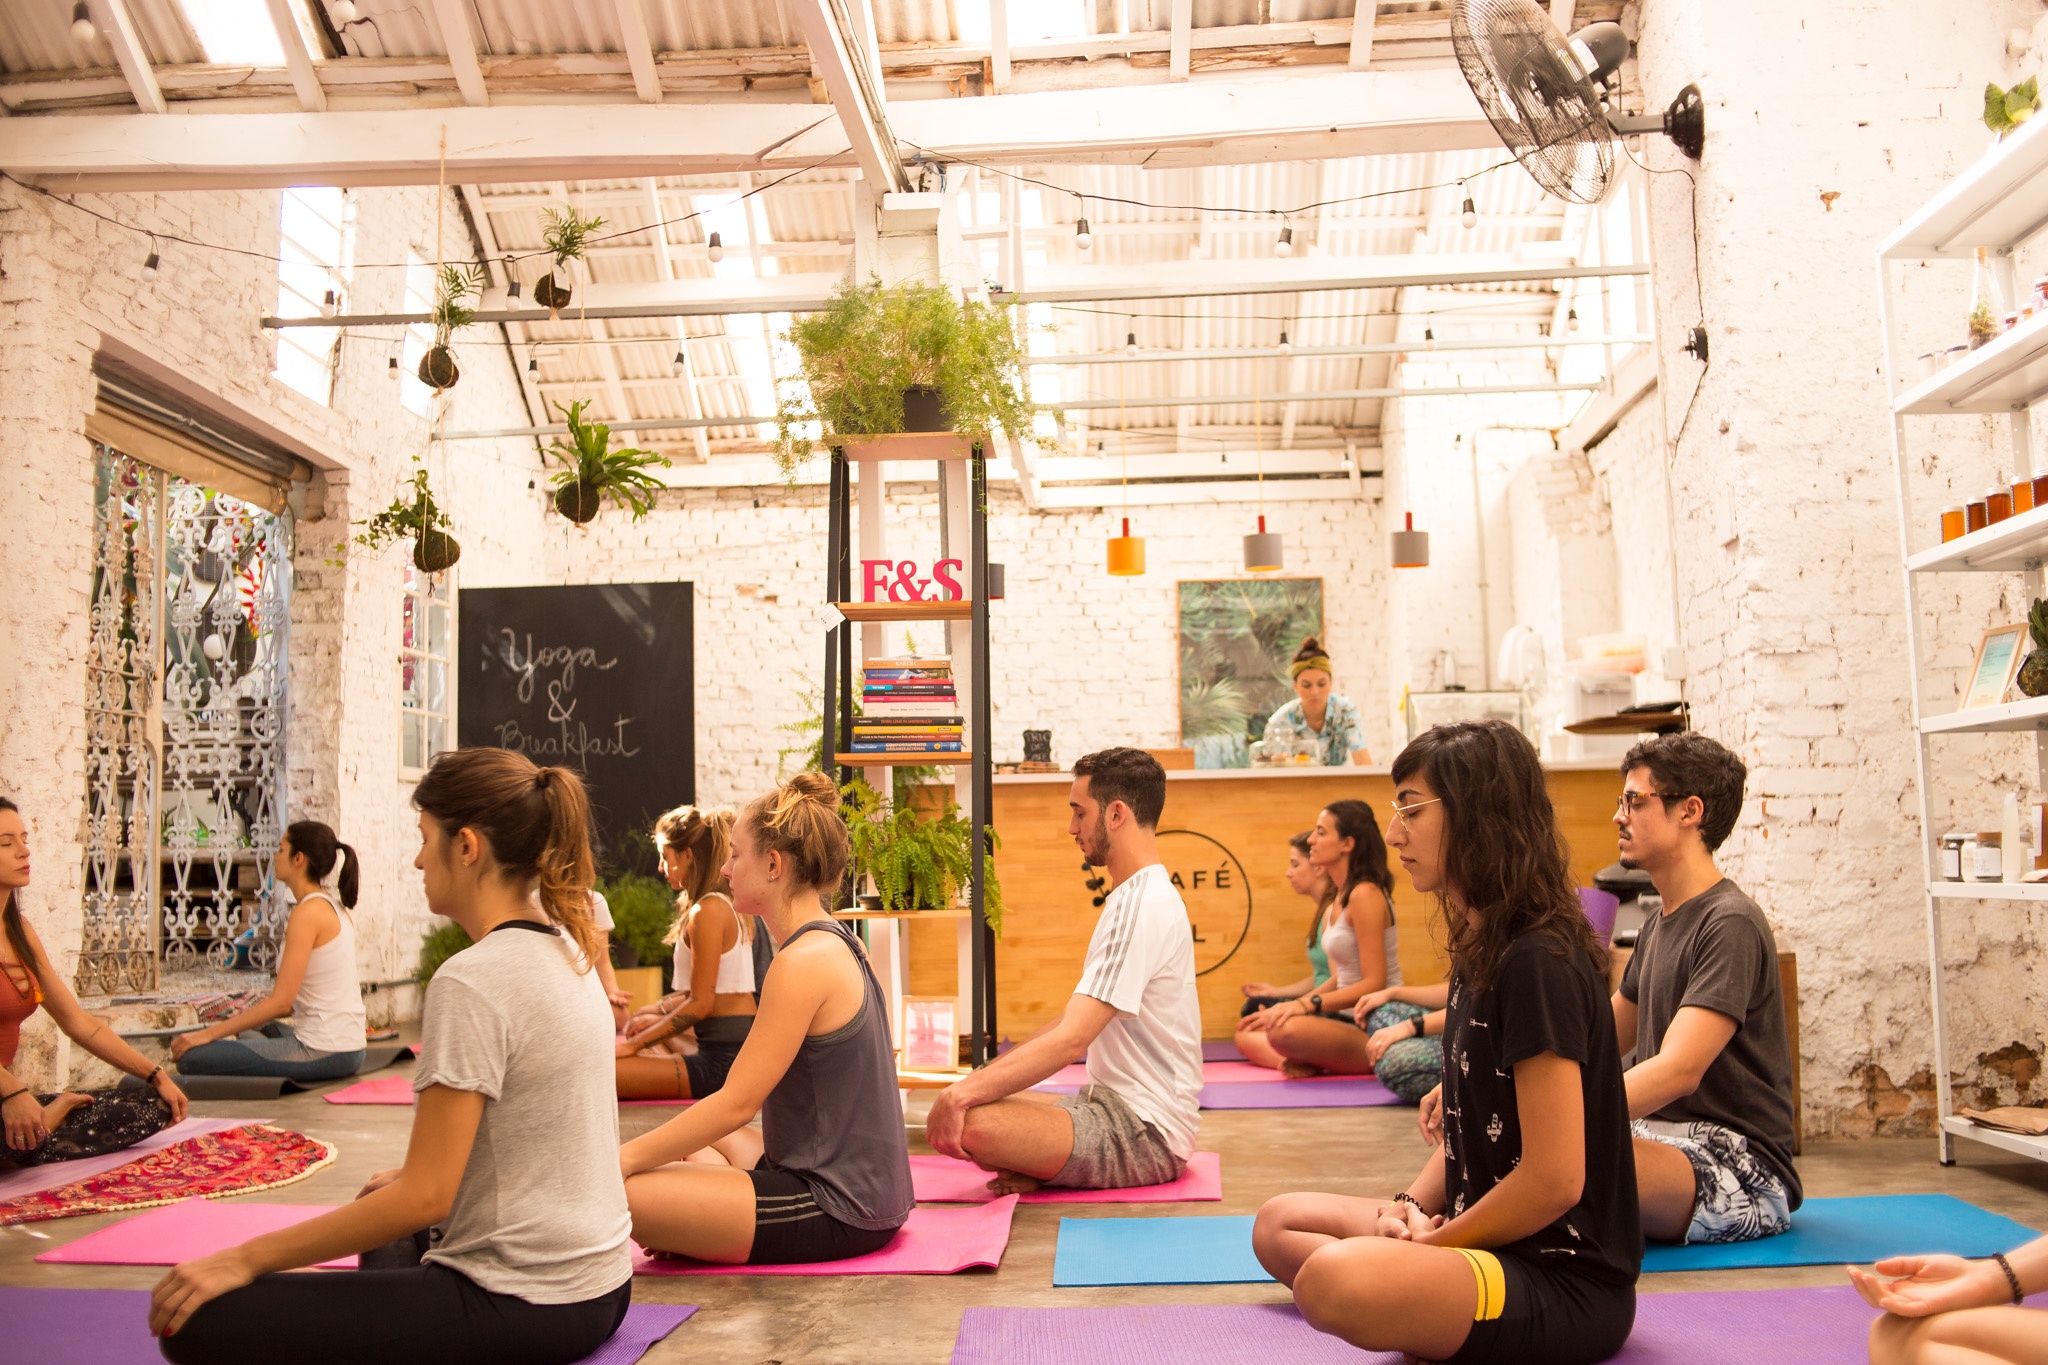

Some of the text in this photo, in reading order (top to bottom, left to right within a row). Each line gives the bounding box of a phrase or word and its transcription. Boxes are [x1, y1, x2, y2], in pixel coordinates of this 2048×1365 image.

[861, 558, 963, 603] F&S
[500, 626, 618, 704] Yoga
[547, 679, 577, 723] &
[494, 713, 641, 773] Breakfast
[1170, 861, 1231, 890] AFÉ
